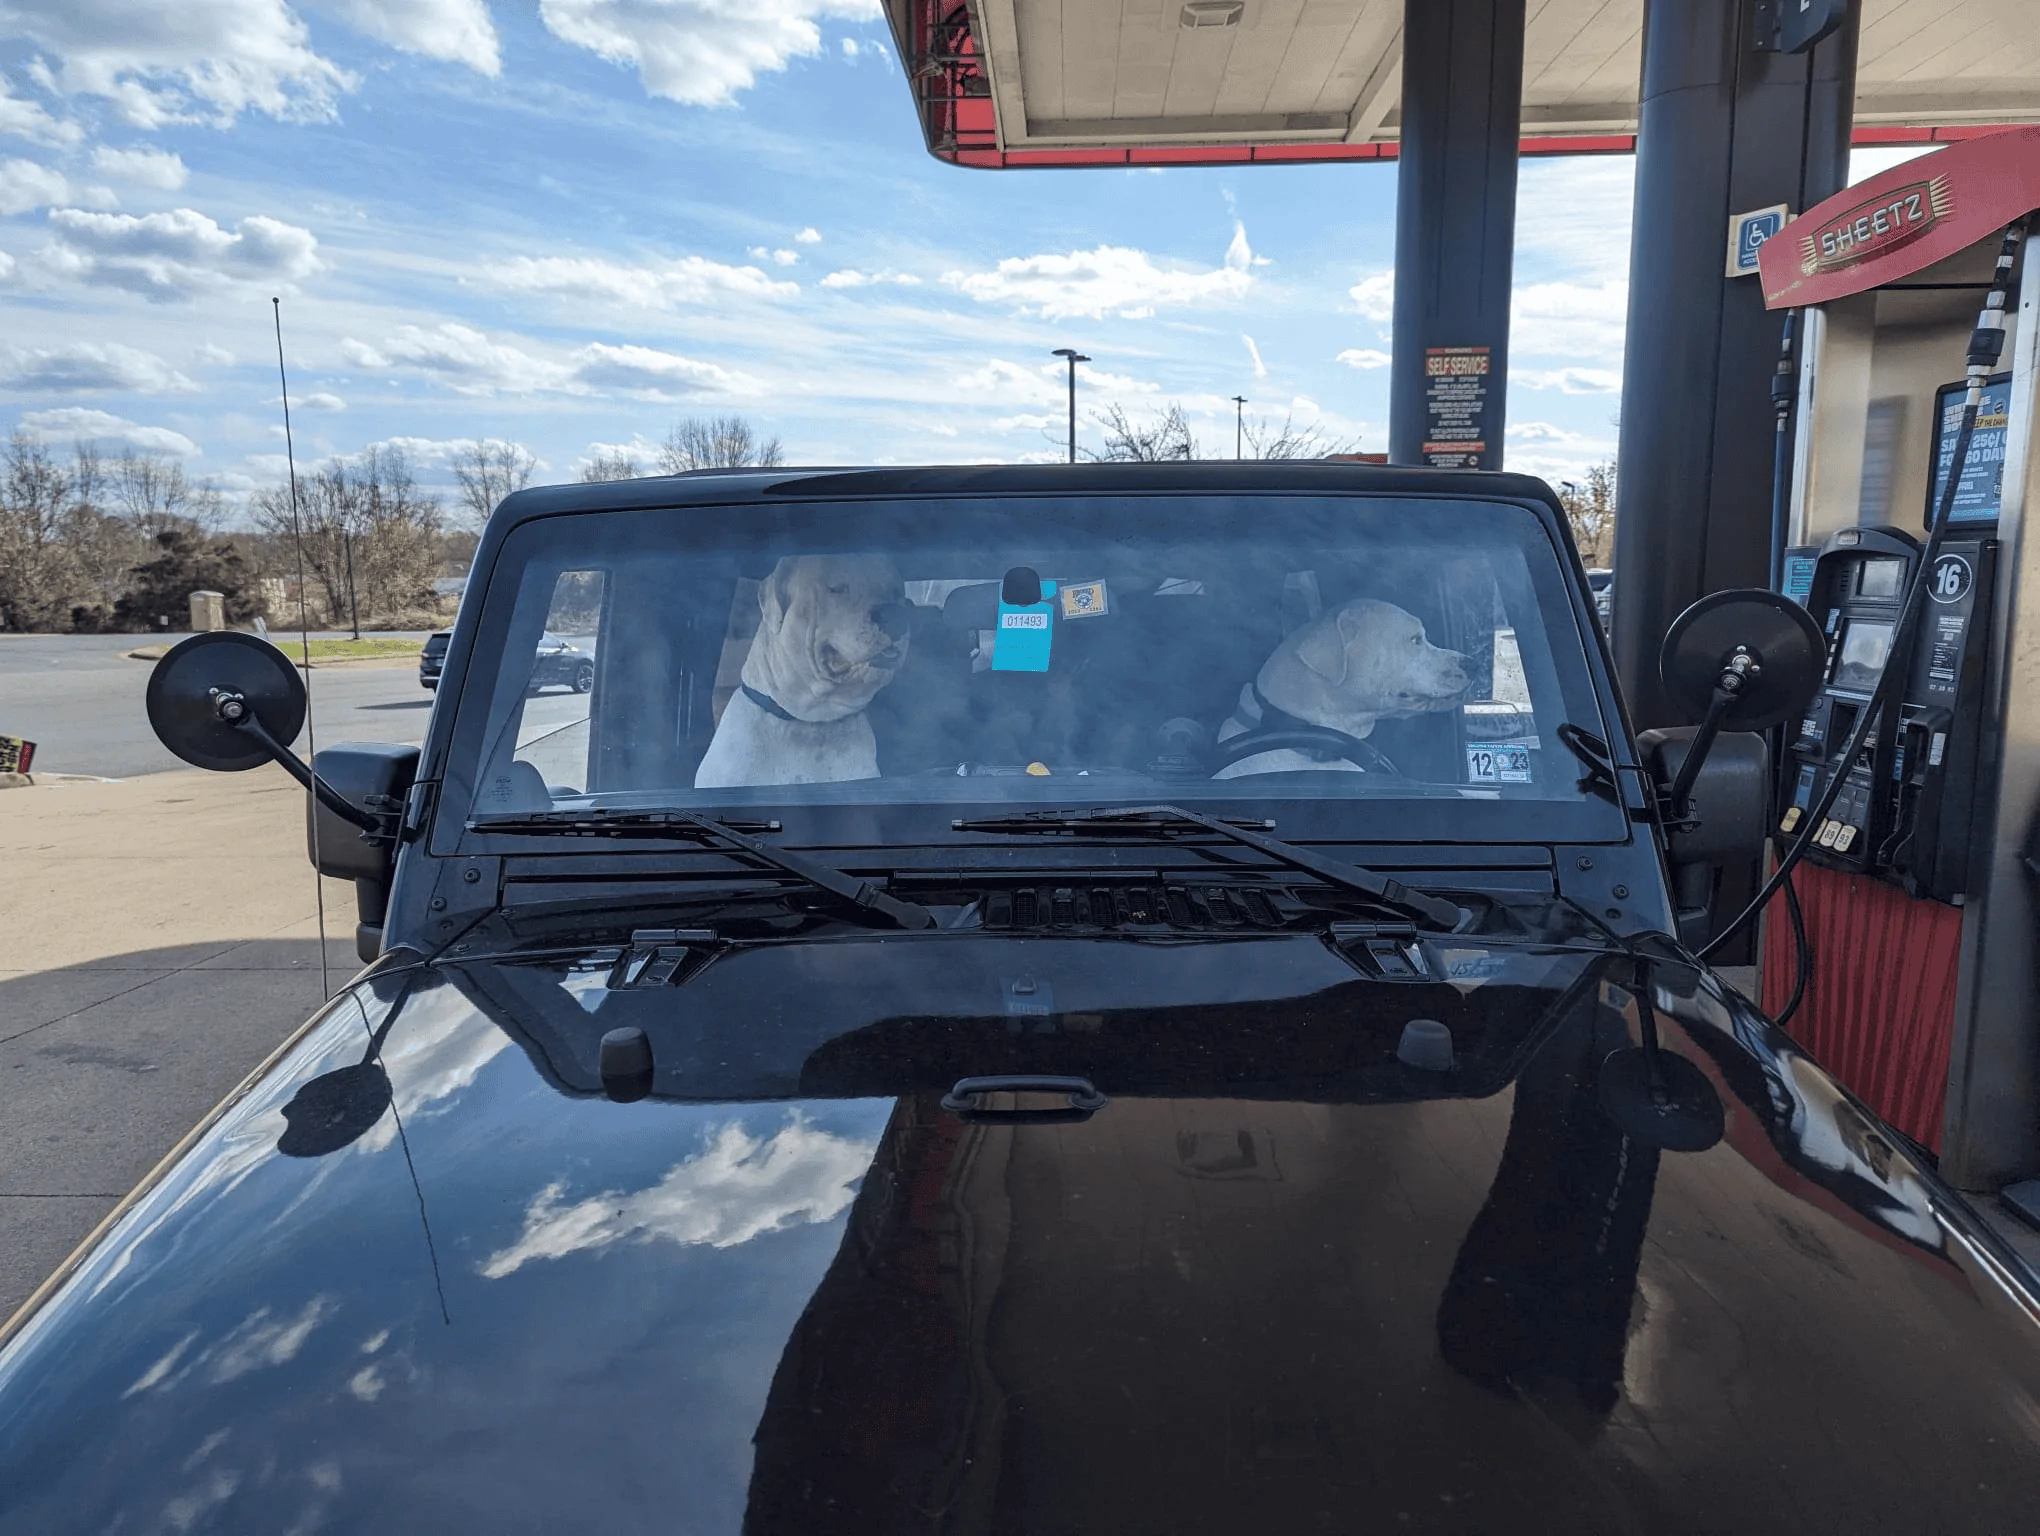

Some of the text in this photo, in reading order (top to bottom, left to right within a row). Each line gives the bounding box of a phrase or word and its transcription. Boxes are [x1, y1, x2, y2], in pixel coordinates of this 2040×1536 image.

[1821, 193, 1923, 256] SHEETZ
[1428, 356, 1488, 375] SELF SERVICE
[1940, 453, 1954, 467] FO
[1965, 450, 1980, 464] 60
[1937, 564, 1962, 595] 16
[1007, 616, 1042, 627] 011493
[1471, 752, 1529, 776] 12 23
